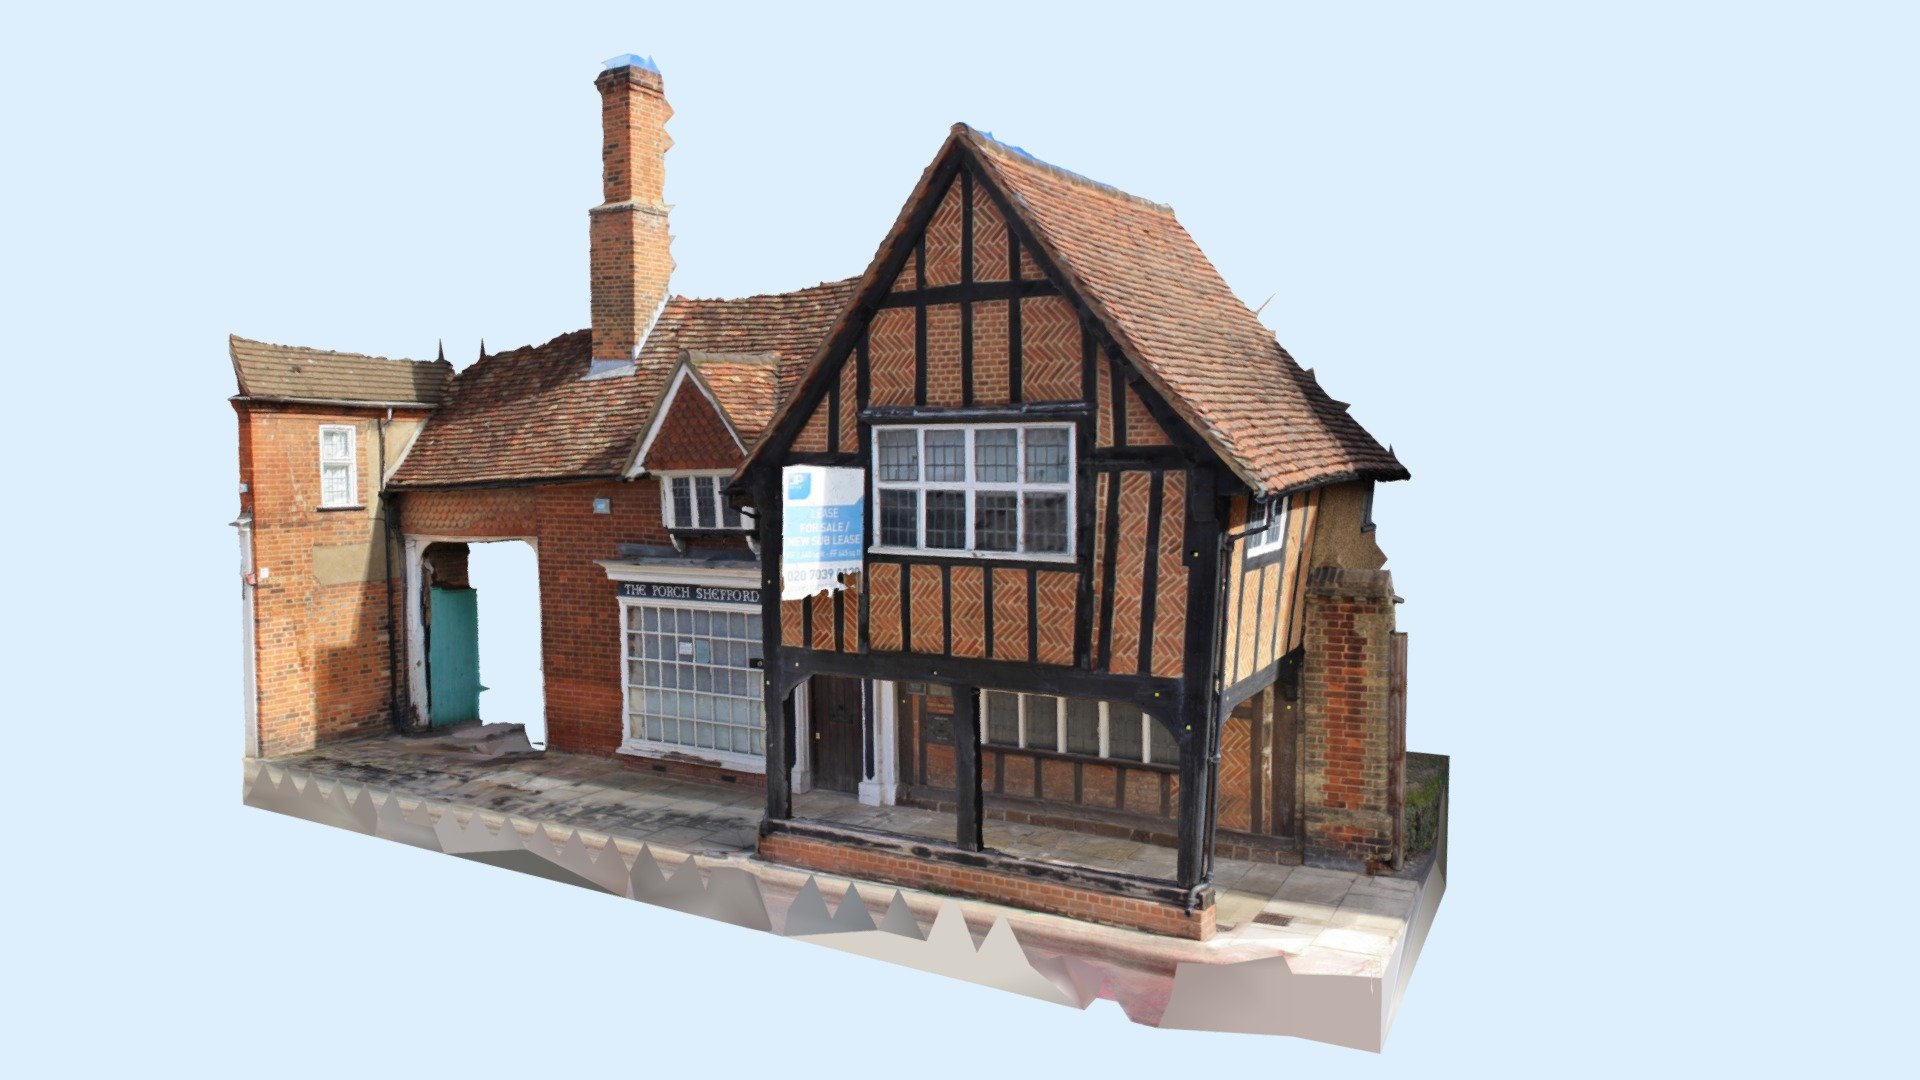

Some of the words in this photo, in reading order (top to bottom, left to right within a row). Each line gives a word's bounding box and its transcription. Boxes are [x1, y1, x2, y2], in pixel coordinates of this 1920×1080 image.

[811, 507, 839, 518] LEASE
[800, 523, 817, 533] FOR
[821, 521, 844, 532] SALE
[789, 536, 810, 547] NEW
[811, 535, 830, 546] SUB
[832, 533, 861, 545] LEASE
[787, 570, 807, 582] 020
[809, 568, 834, 581] 7039
[624, 583, 647, 596] THE
[652, 585, 690, 599] PORCH
[695, 587, 760, 603] SHEFFORD
